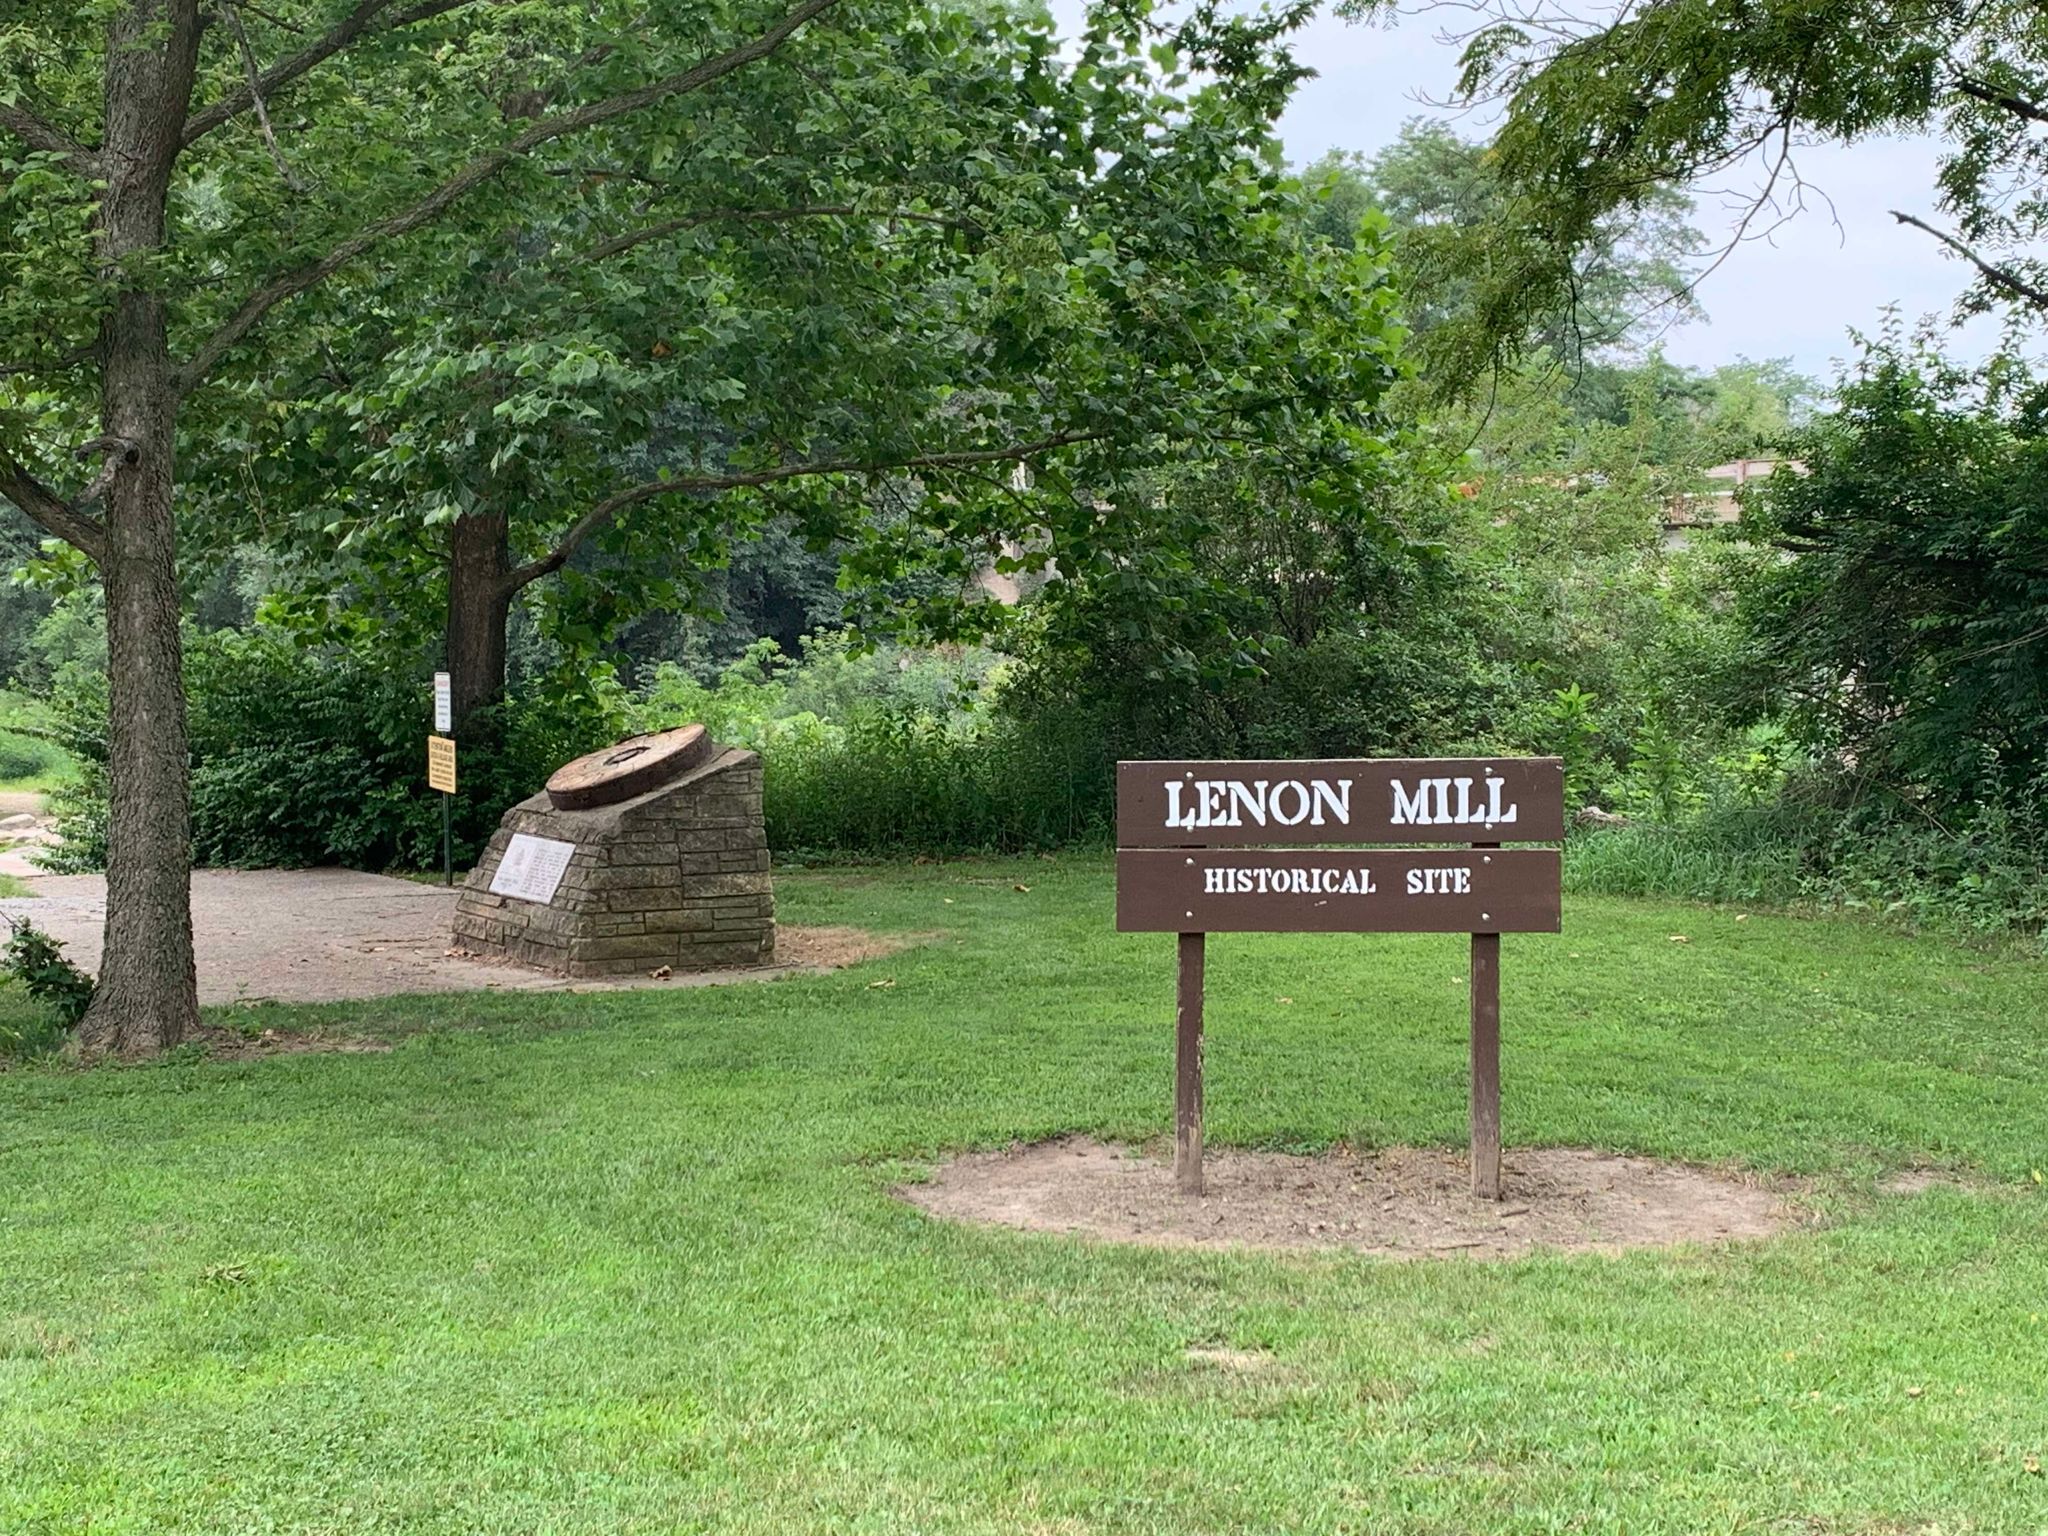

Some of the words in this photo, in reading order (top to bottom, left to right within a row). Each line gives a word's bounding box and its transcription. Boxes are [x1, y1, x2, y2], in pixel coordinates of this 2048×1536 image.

[1164, 779, 1353, 827] LENON
[1390, 776, 1518, 825] MILL
[1204, 867, 1376, 895] HISTORICAL
[1406, 866, 1472, 895] SITE
